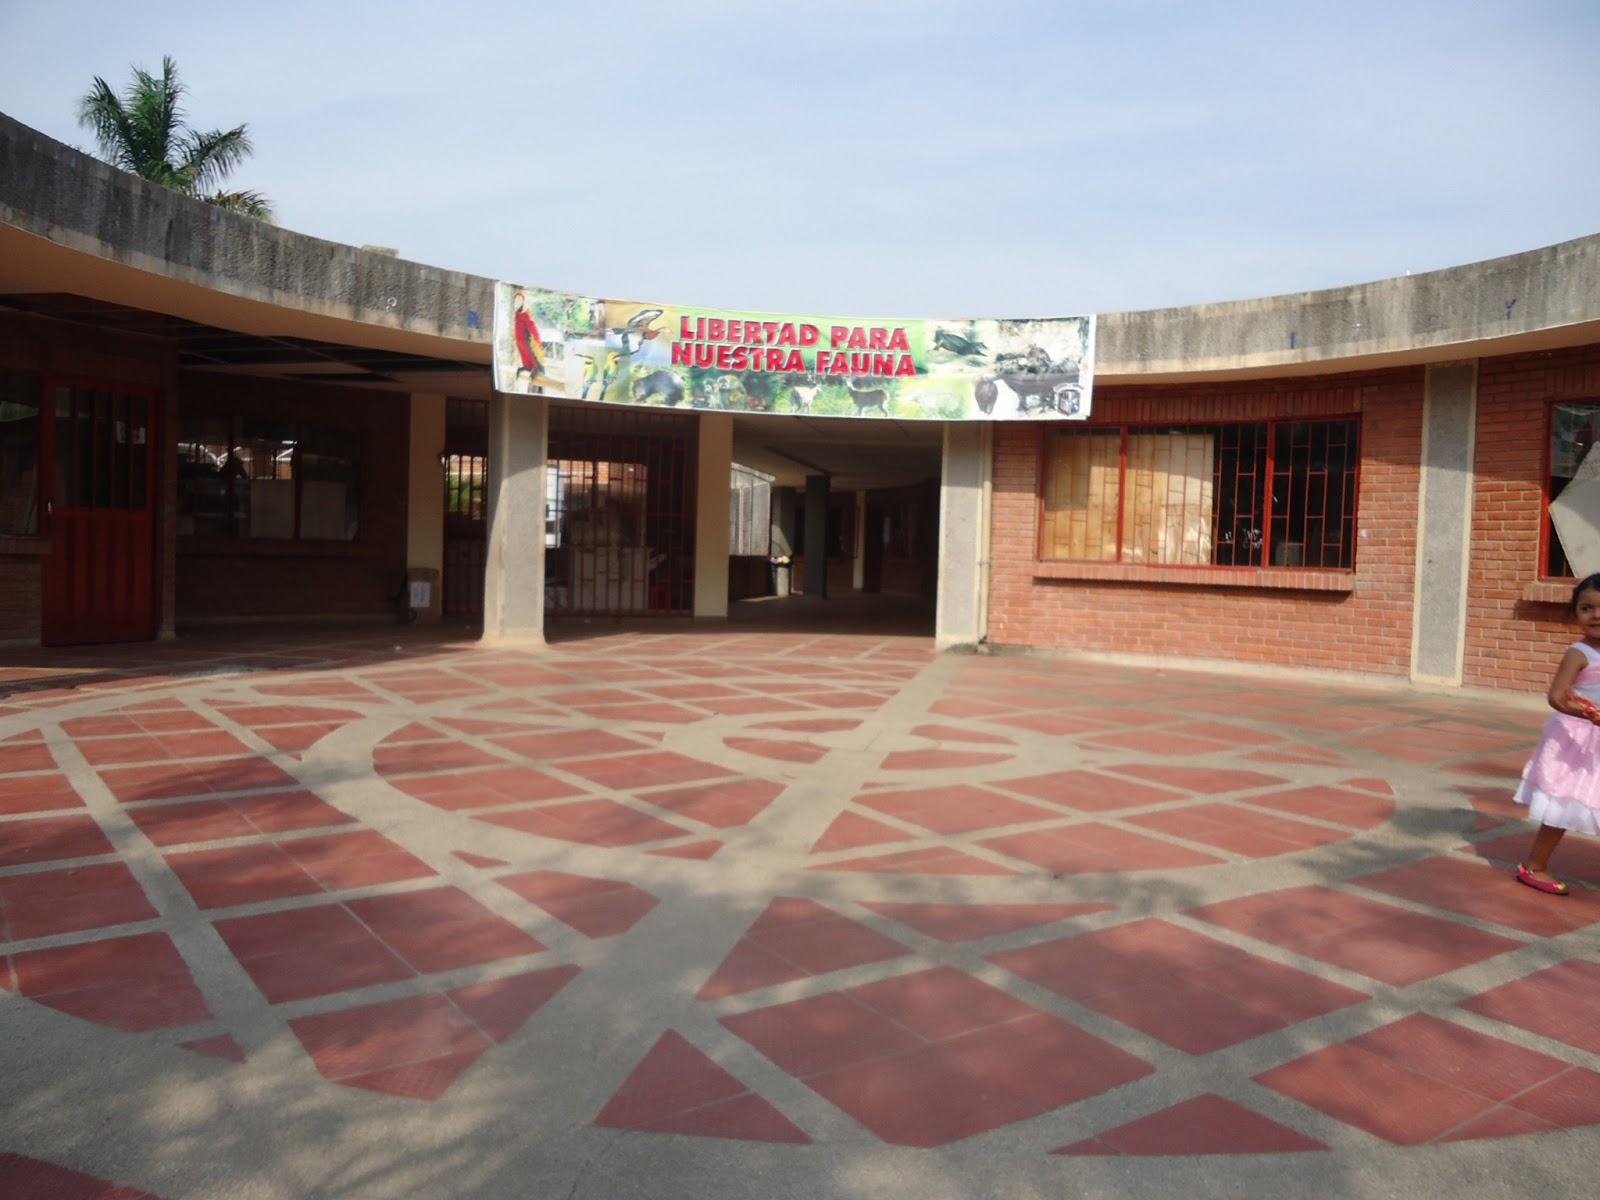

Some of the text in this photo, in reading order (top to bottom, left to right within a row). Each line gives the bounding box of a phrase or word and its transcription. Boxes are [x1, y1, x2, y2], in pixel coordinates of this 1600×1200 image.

[680, 315, 911, 351] LIBERTAD PARA
[671, 341, 917, 377] NUESTRA FAUNA
